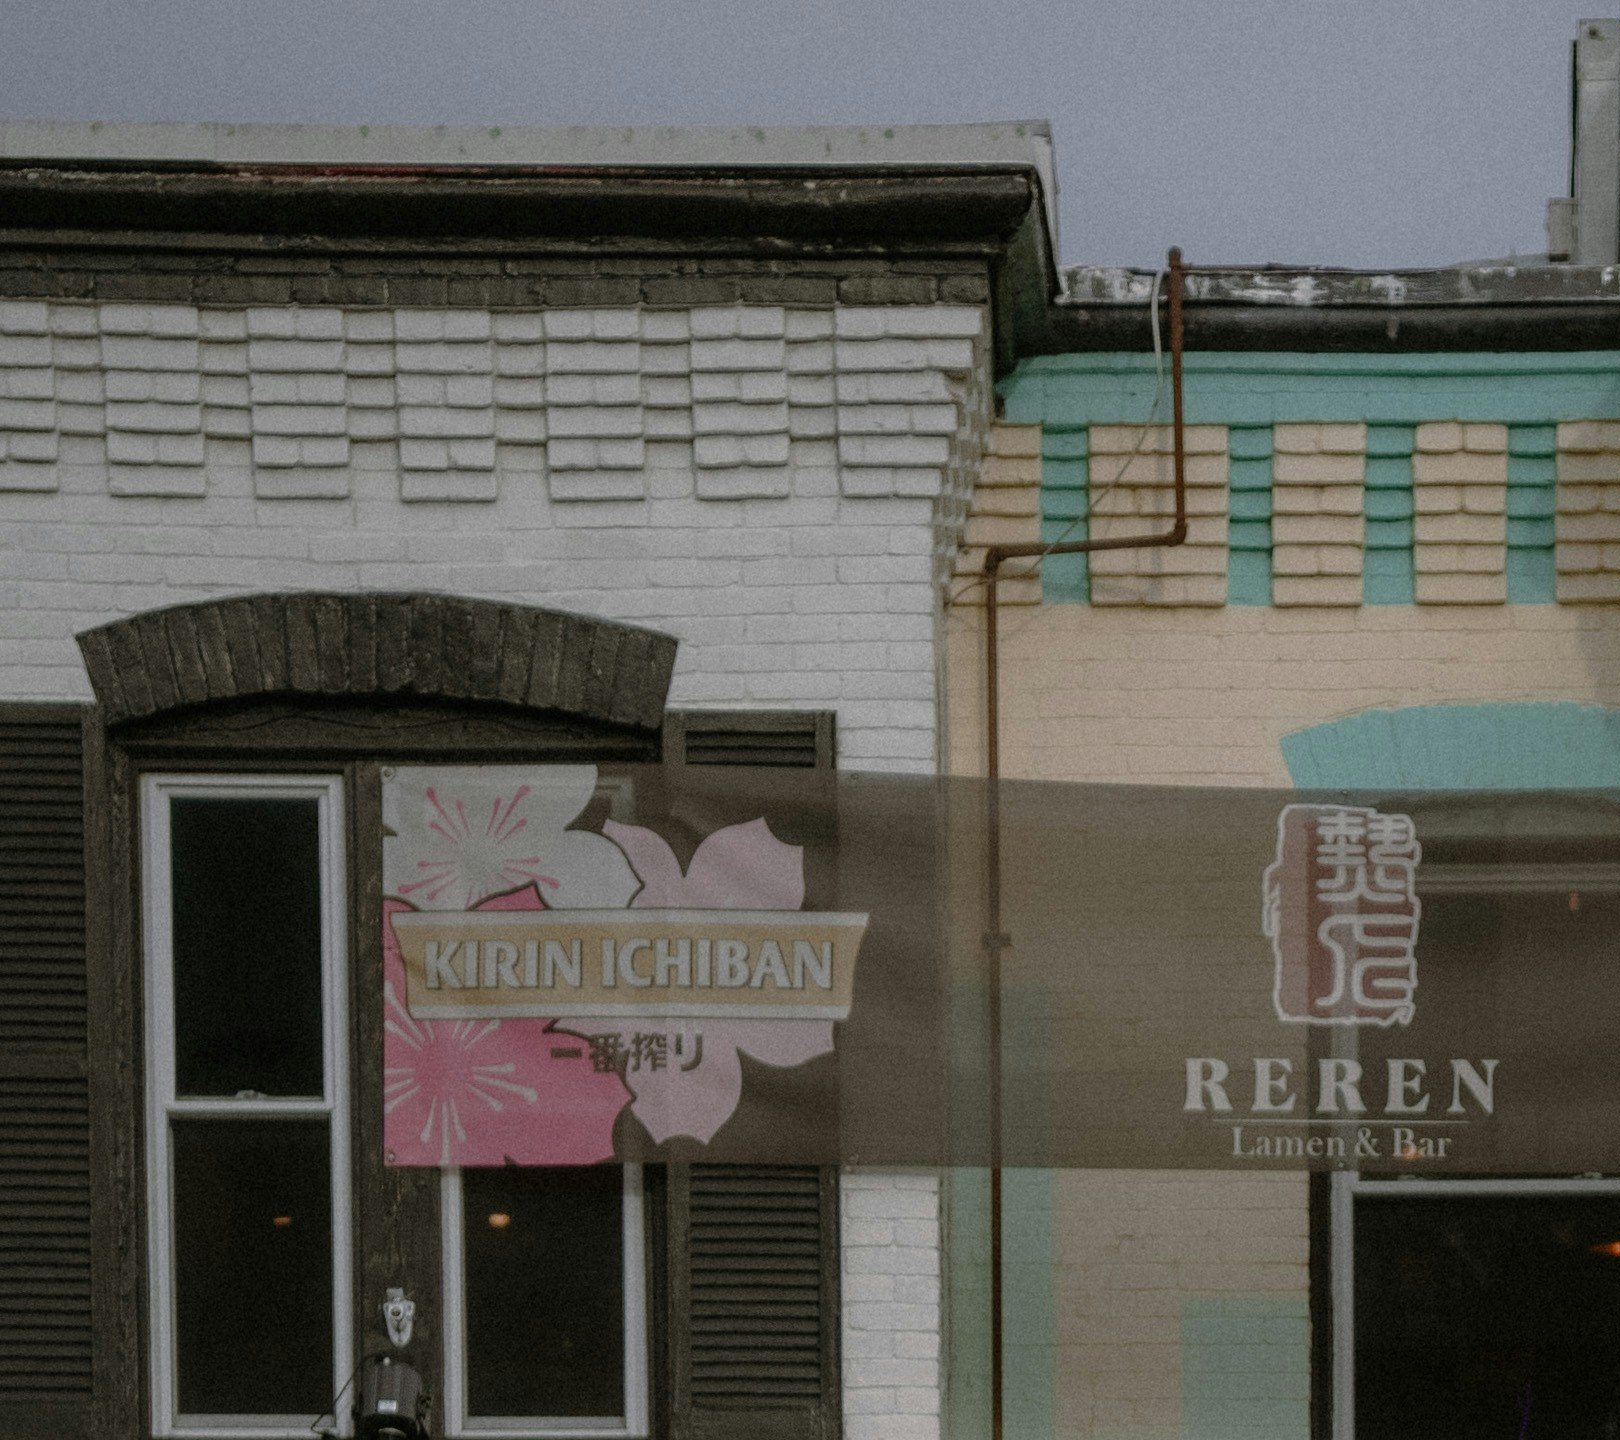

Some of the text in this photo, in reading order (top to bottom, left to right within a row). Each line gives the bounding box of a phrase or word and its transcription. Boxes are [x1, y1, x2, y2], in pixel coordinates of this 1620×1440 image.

[424, 938, 834, 990] KIRIN ICHIBAN
[550, 1032, 705, 1073] 一番搾り
[1183, 1057, 1500, 1114] REREN
[1232, 1126, 1453, 1158] Lamen & Bar
